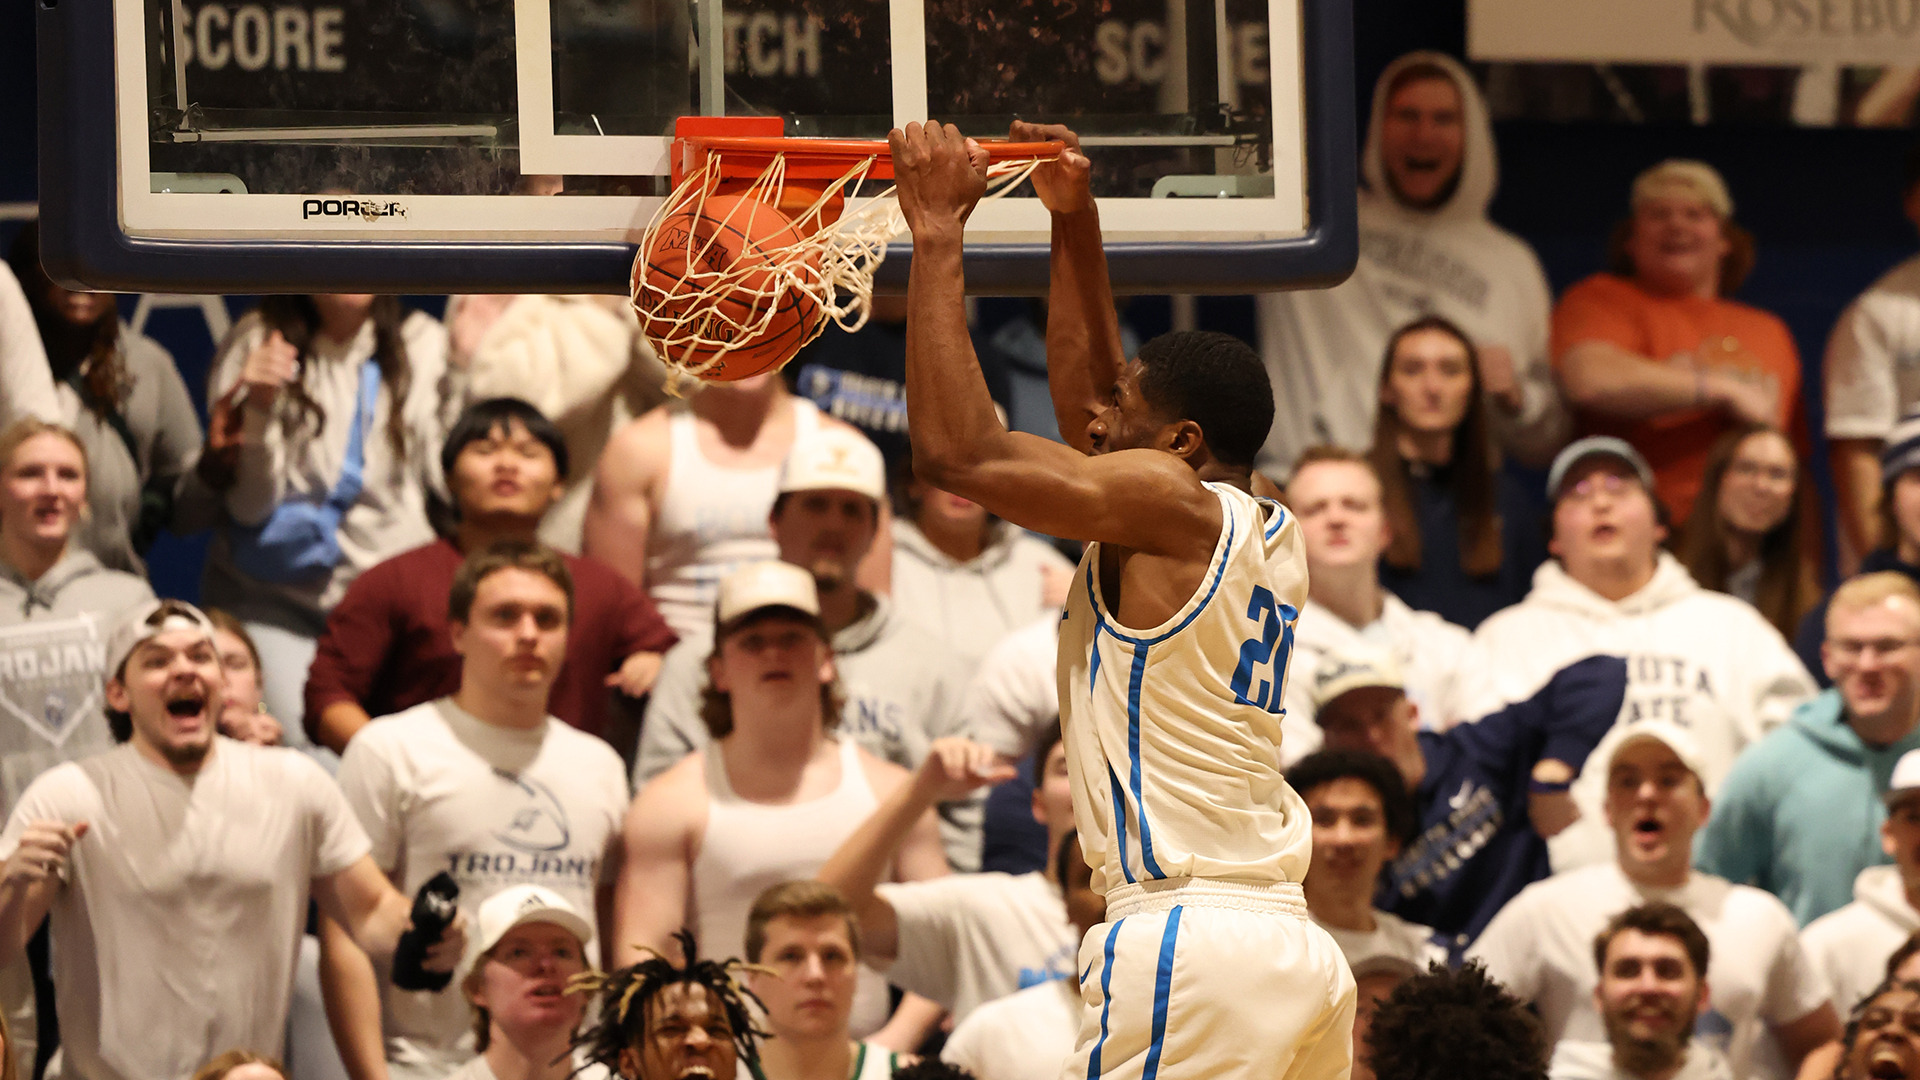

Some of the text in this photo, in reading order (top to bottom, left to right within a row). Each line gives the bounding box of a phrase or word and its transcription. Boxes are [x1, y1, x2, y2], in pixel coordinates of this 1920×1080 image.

[689, 11, 820, 77] TCH
[1095, 20, 1269, 84] SCE
[659, 227, 729, 273] NAIA
[637, 287, 735, 343] PALDING
[1628, 655, 1717, 702] OTA
